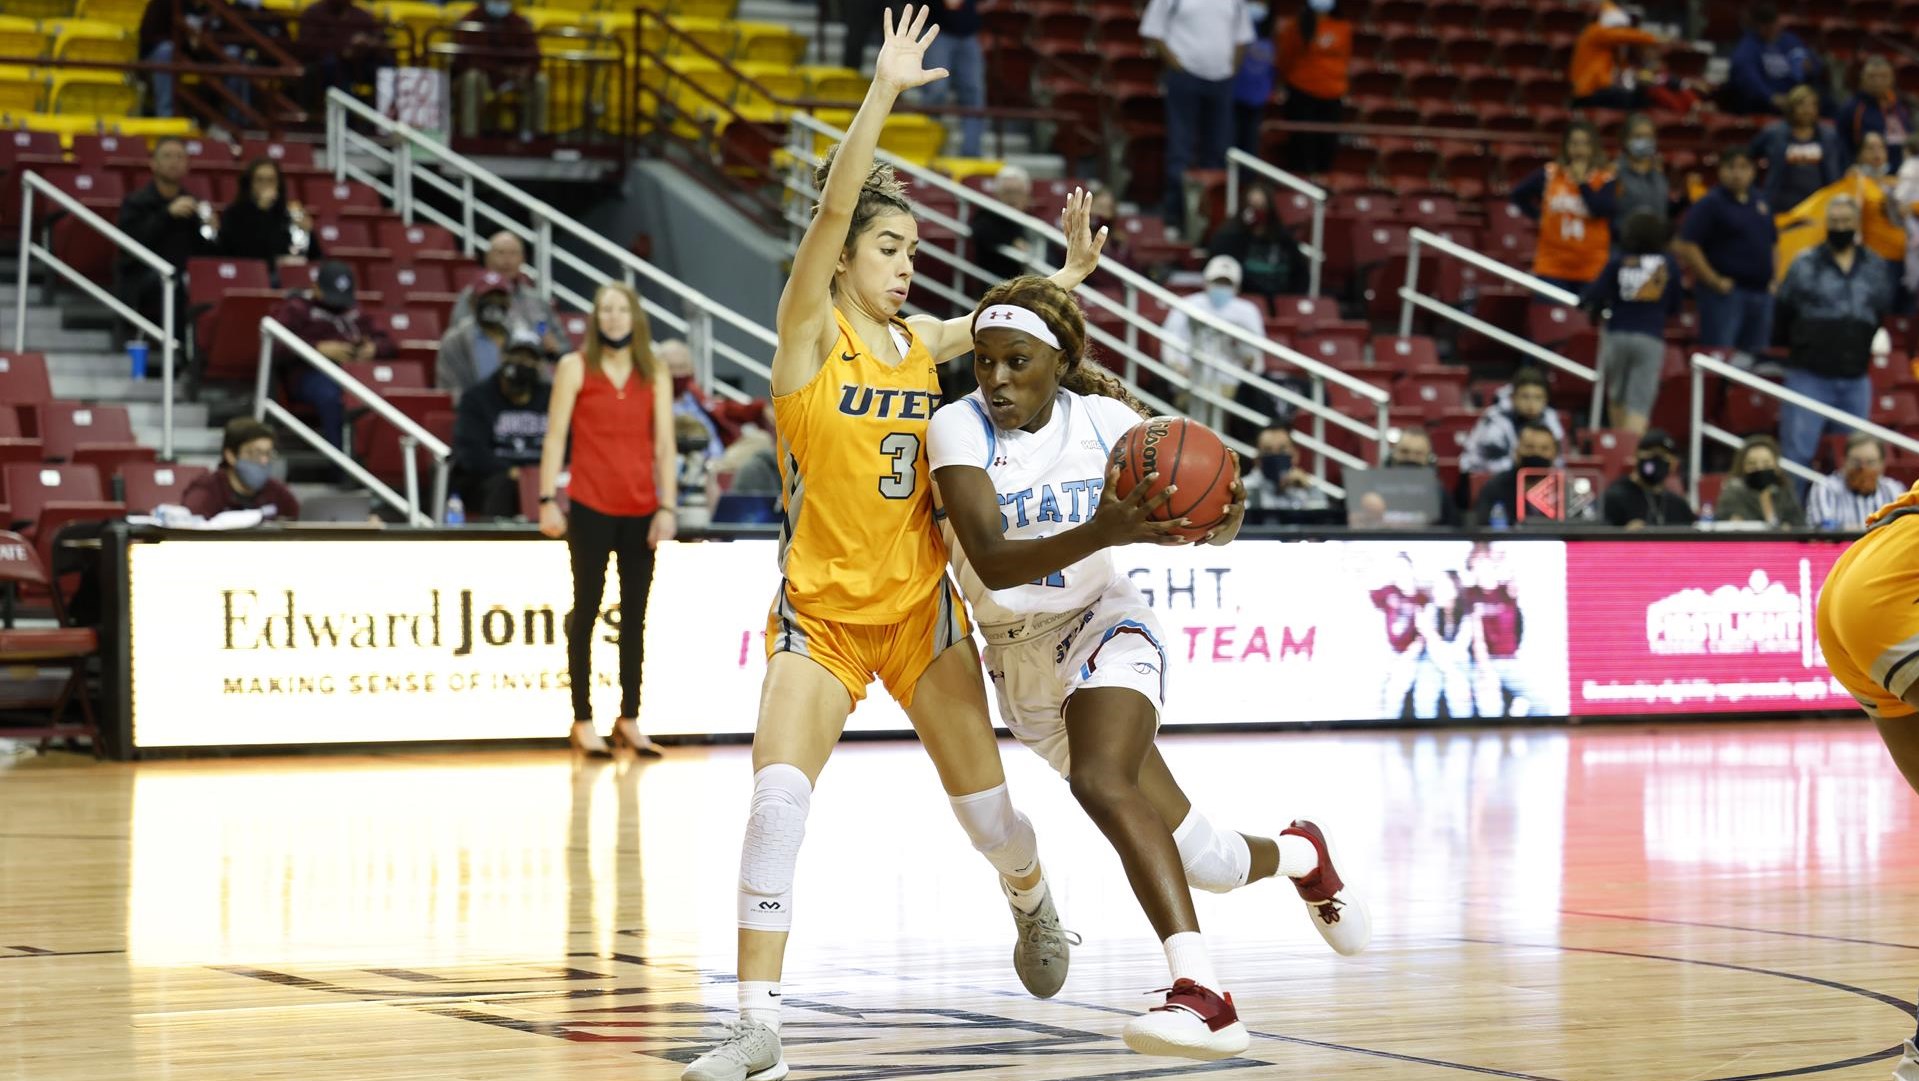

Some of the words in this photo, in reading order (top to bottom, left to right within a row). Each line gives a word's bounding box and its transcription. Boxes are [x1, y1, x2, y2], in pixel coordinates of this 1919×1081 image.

[838, 383, 943, 420] UTEP
[878, 431, 921, 500] 3
[220, 588, 442, 650] Edward
[452, 588, 621, 657] Jons
[1182, 625, 1317, 662] TEAM
[223, 676, 335, 694] MAKING
[349, 673, 434, 694] SENSE
[448, 672, 480, 691] OF
